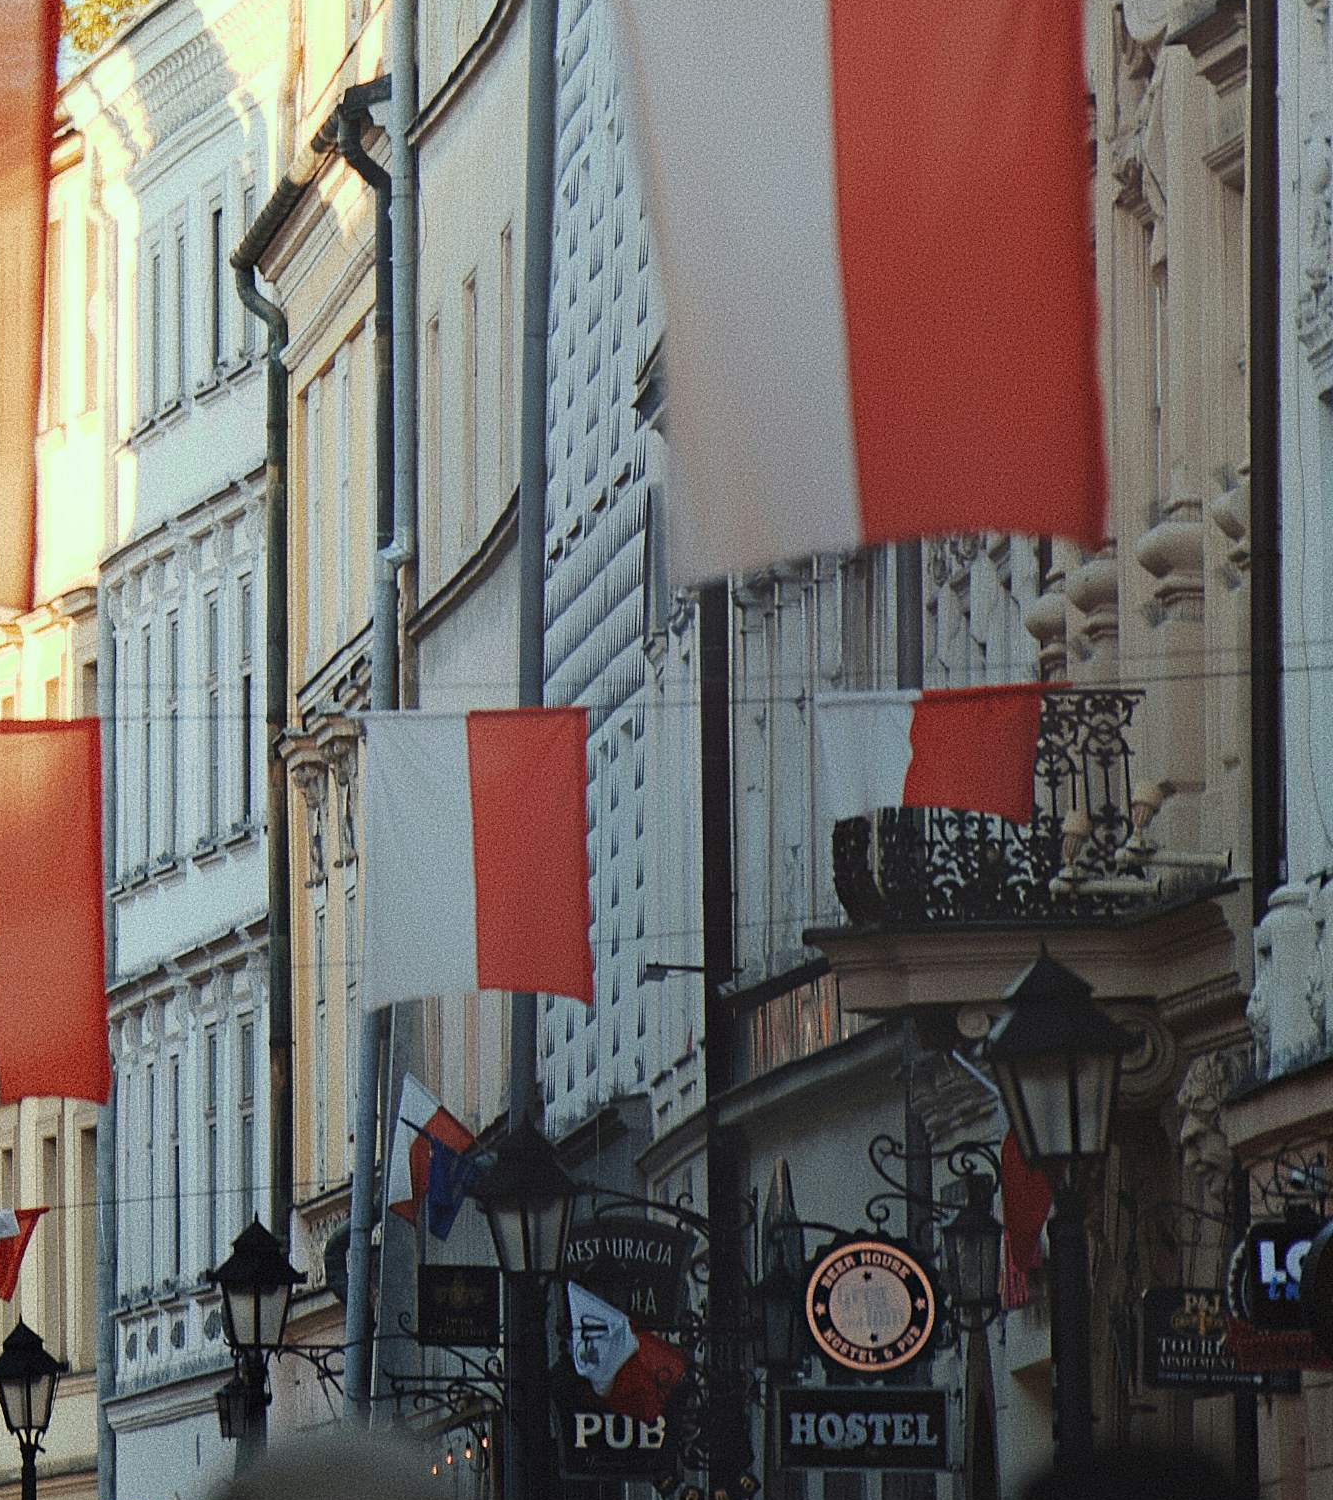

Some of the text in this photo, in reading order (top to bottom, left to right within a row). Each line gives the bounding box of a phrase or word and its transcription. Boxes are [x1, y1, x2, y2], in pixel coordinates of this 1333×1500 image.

[820, 1251, 912, 1289] BEER HOUSE
[823, 1326, 879, 1364] HOSTEL
[896, 1324, 922, 1353] PUB
[573, 1412, 667, 1451] PUB
[789, 1411, 939, 1447] HOSTEL
